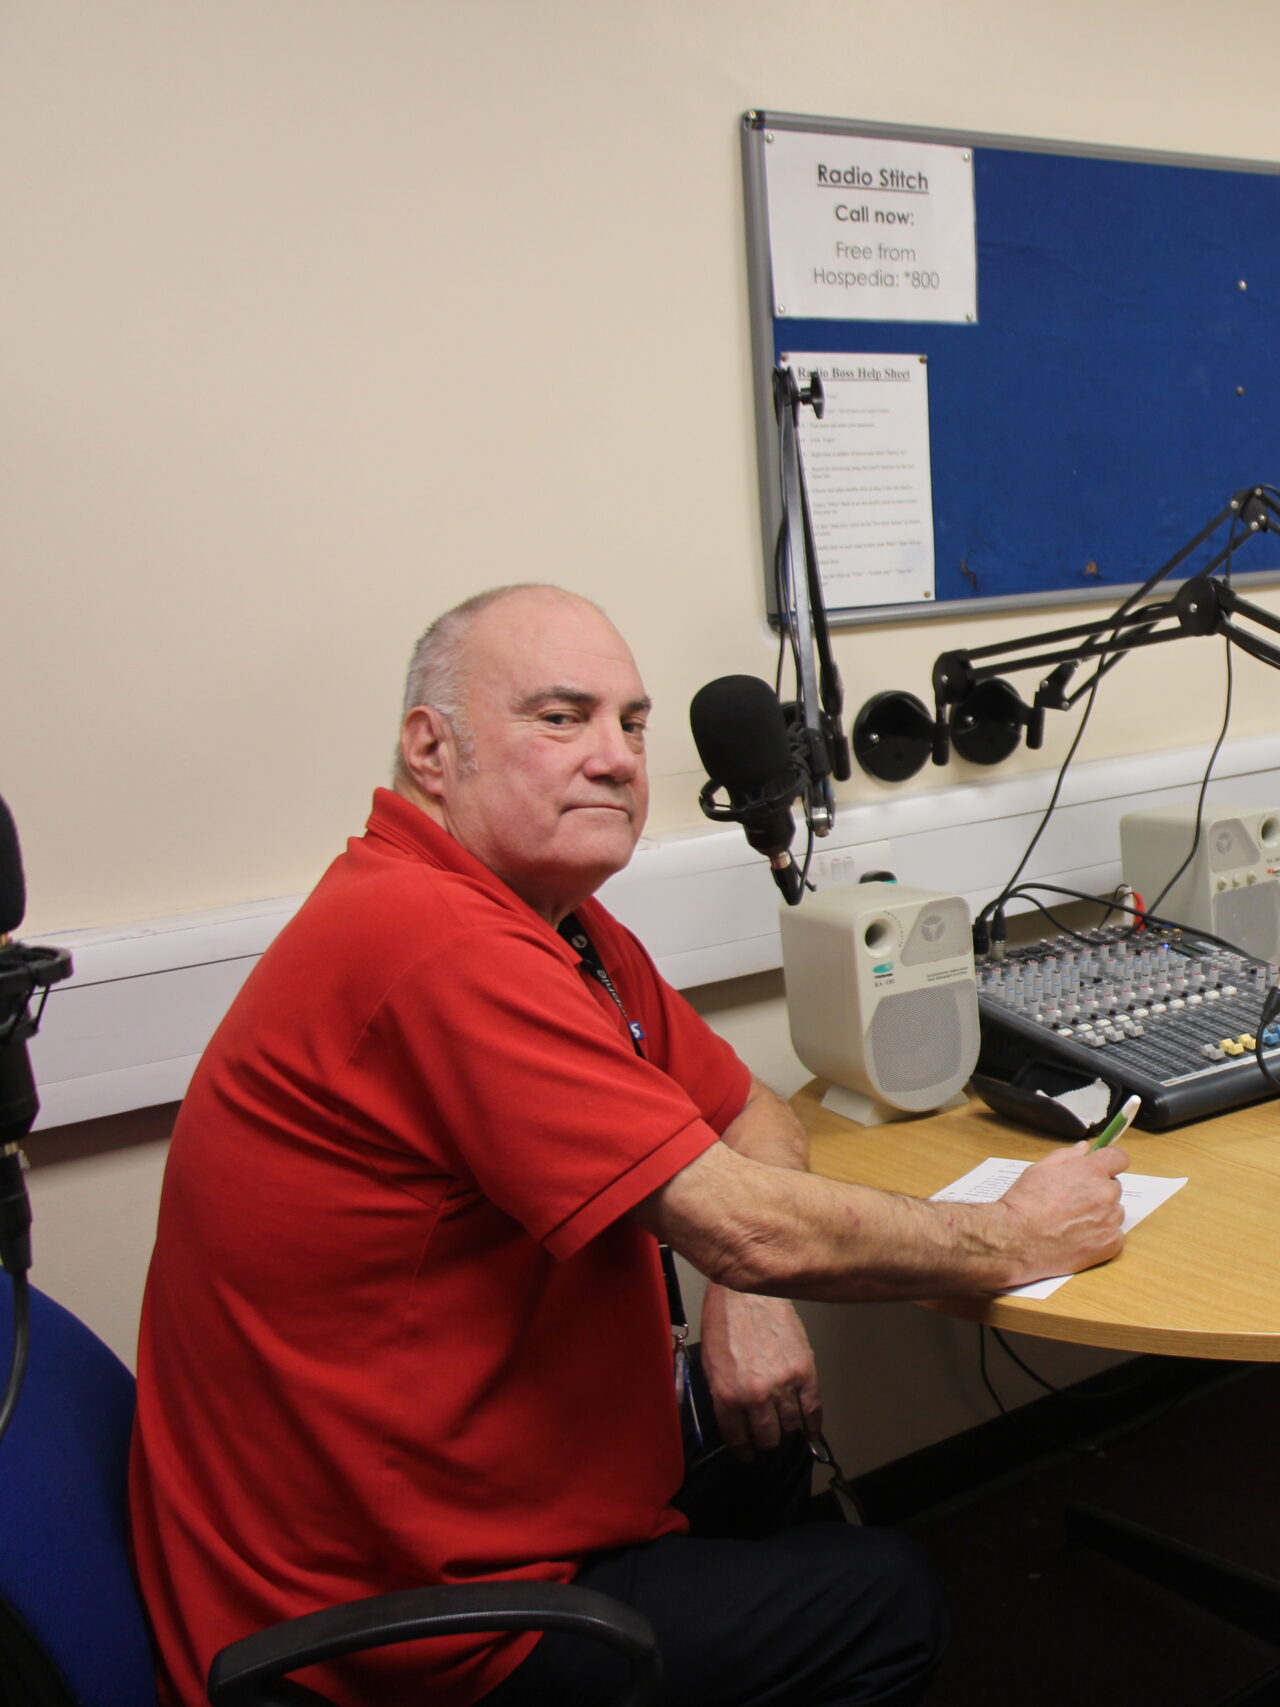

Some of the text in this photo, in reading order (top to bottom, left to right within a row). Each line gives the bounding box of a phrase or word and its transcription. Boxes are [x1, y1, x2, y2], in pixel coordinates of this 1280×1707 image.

[817, 163, 929, 190] Radio Stitch
[835, 204, 915, 226] Call now:
[836, 241, 917, 262] Free from
[813, 267, 900, 290] Hospedia:
[832, 366, 855, 379] Boss
[858, 367, 882, 381] Help
[884, 367, 911, 379] Sheet
